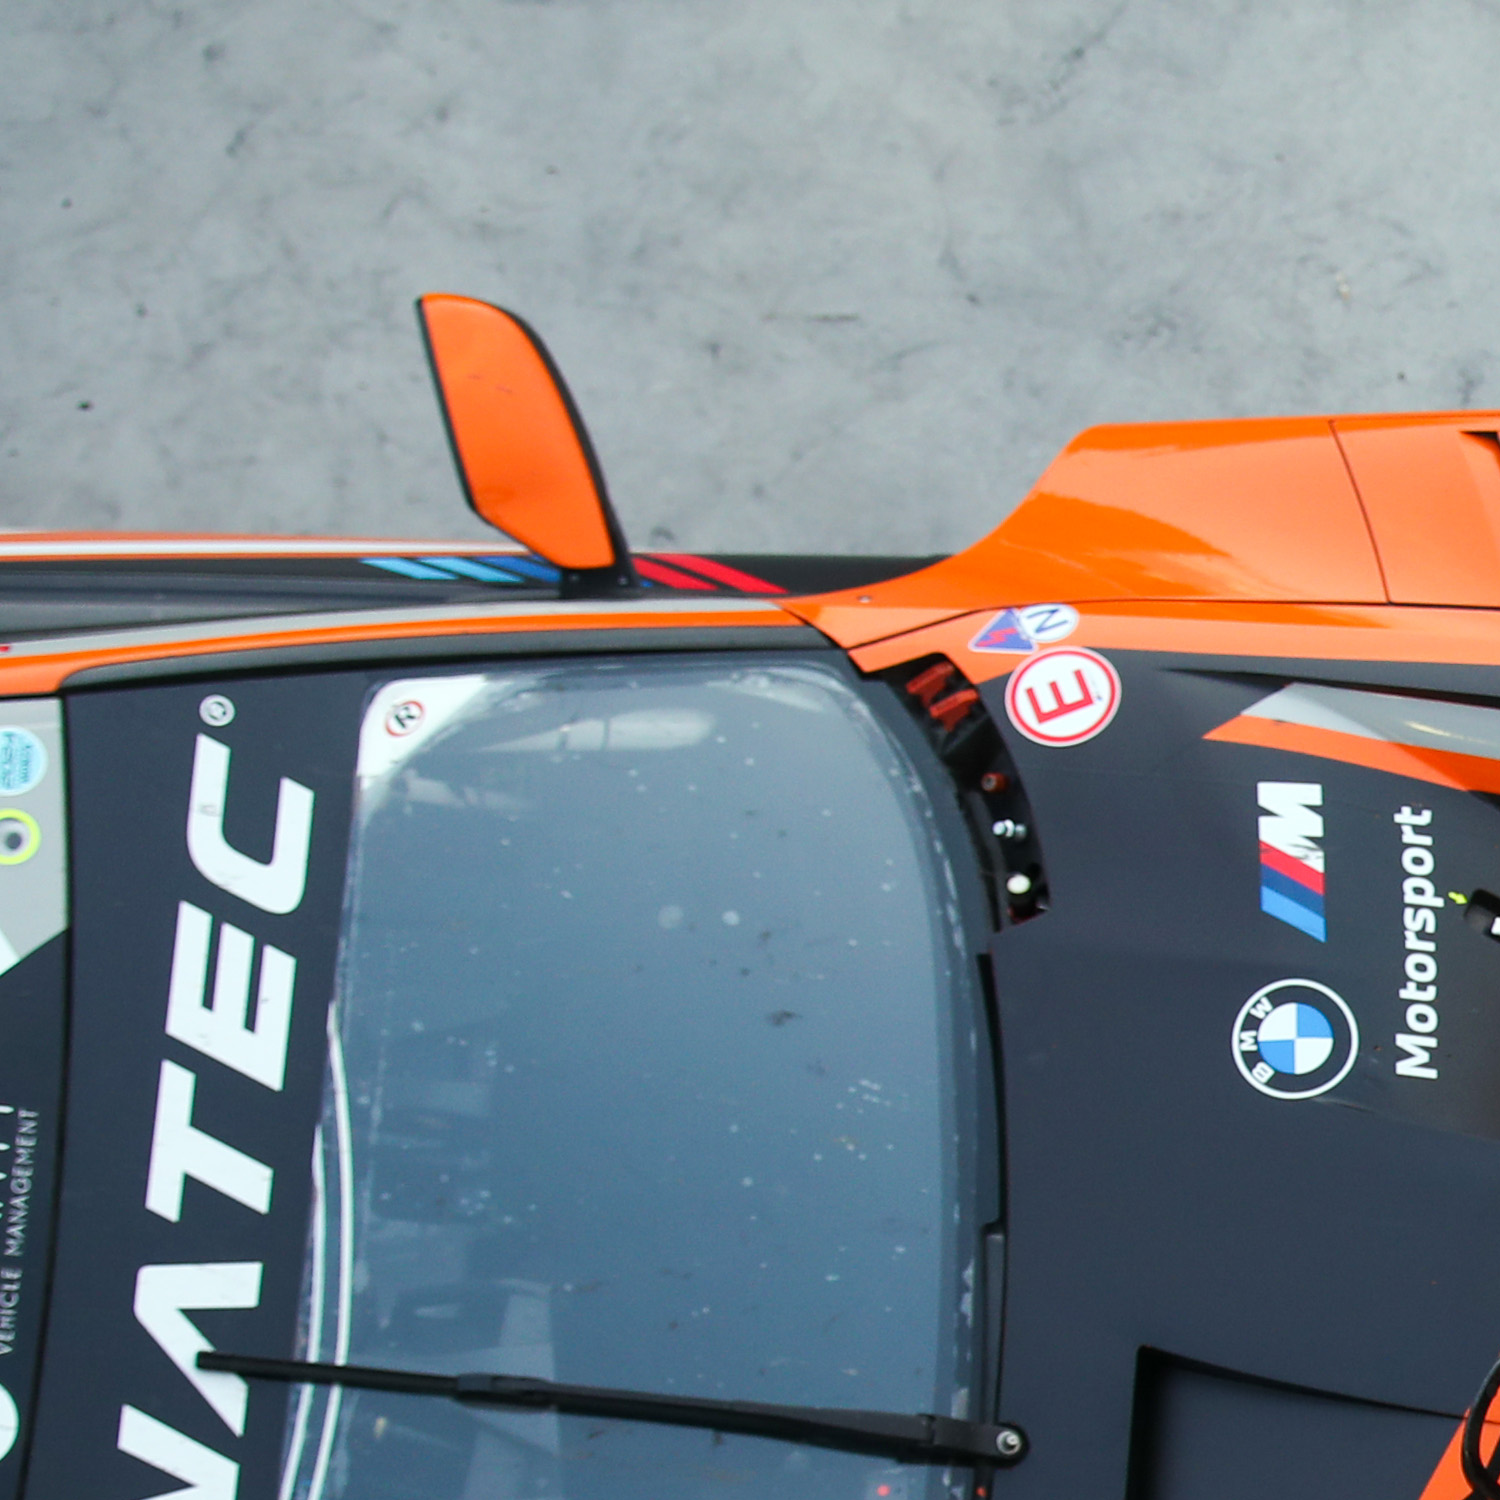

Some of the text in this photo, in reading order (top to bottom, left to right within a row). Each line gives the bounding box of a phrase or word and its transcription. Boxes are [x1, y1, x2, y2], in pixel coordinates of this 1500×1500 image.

[1025, 669, 1095, 725] E
[1394, 805, 1444, 1080] Motorsport
[5, 1107, 39, 1257] MANAGEMENT
